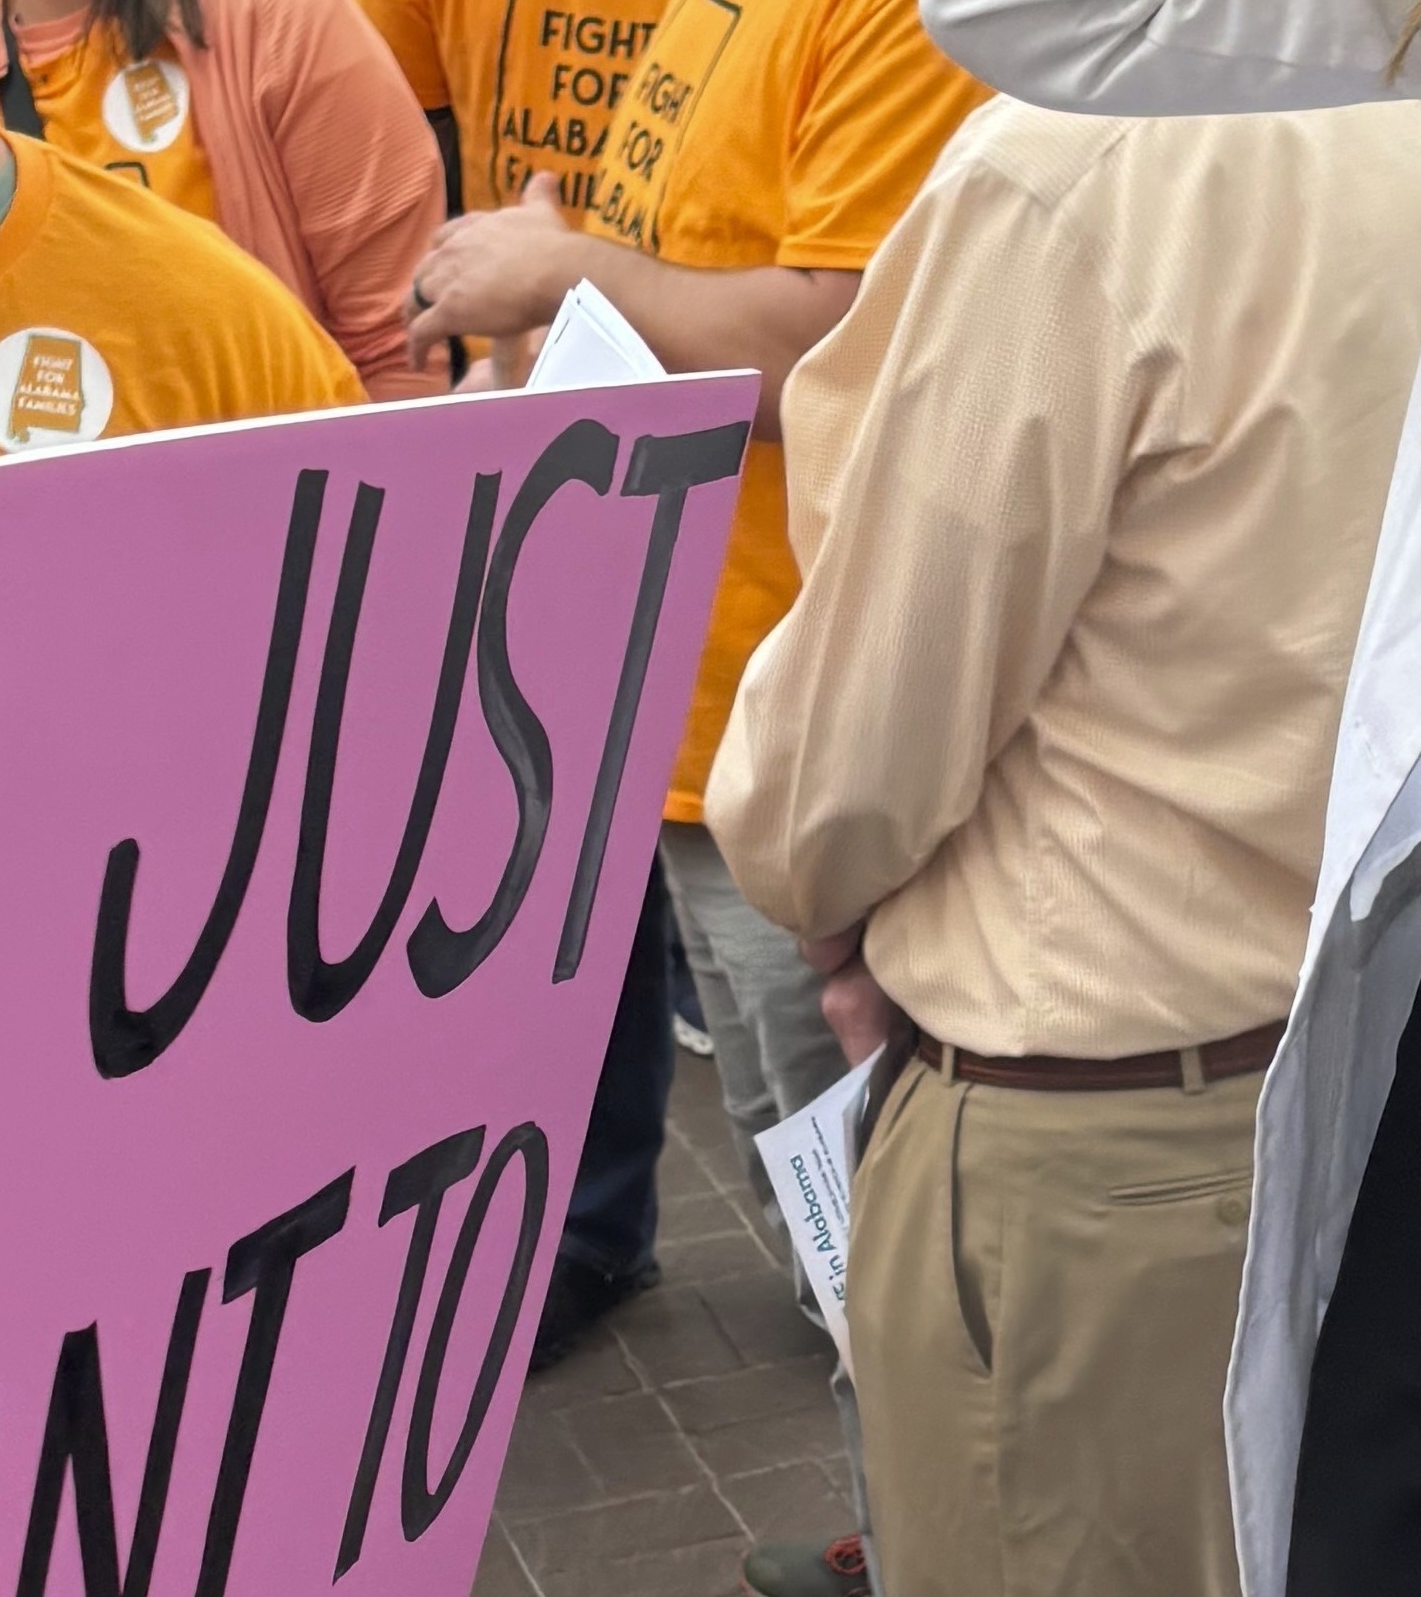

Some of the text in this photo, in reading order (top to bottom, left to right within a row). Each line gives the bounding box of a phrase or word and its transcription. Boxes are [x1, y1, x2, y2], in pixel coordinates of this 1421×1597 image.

[540, 10, 659, 59] FIGHT
[90, 419, 750, 1079] JUST
[790, 1154, 836, 1253] Alabama
[334, 1120, 548, 1585] TO
